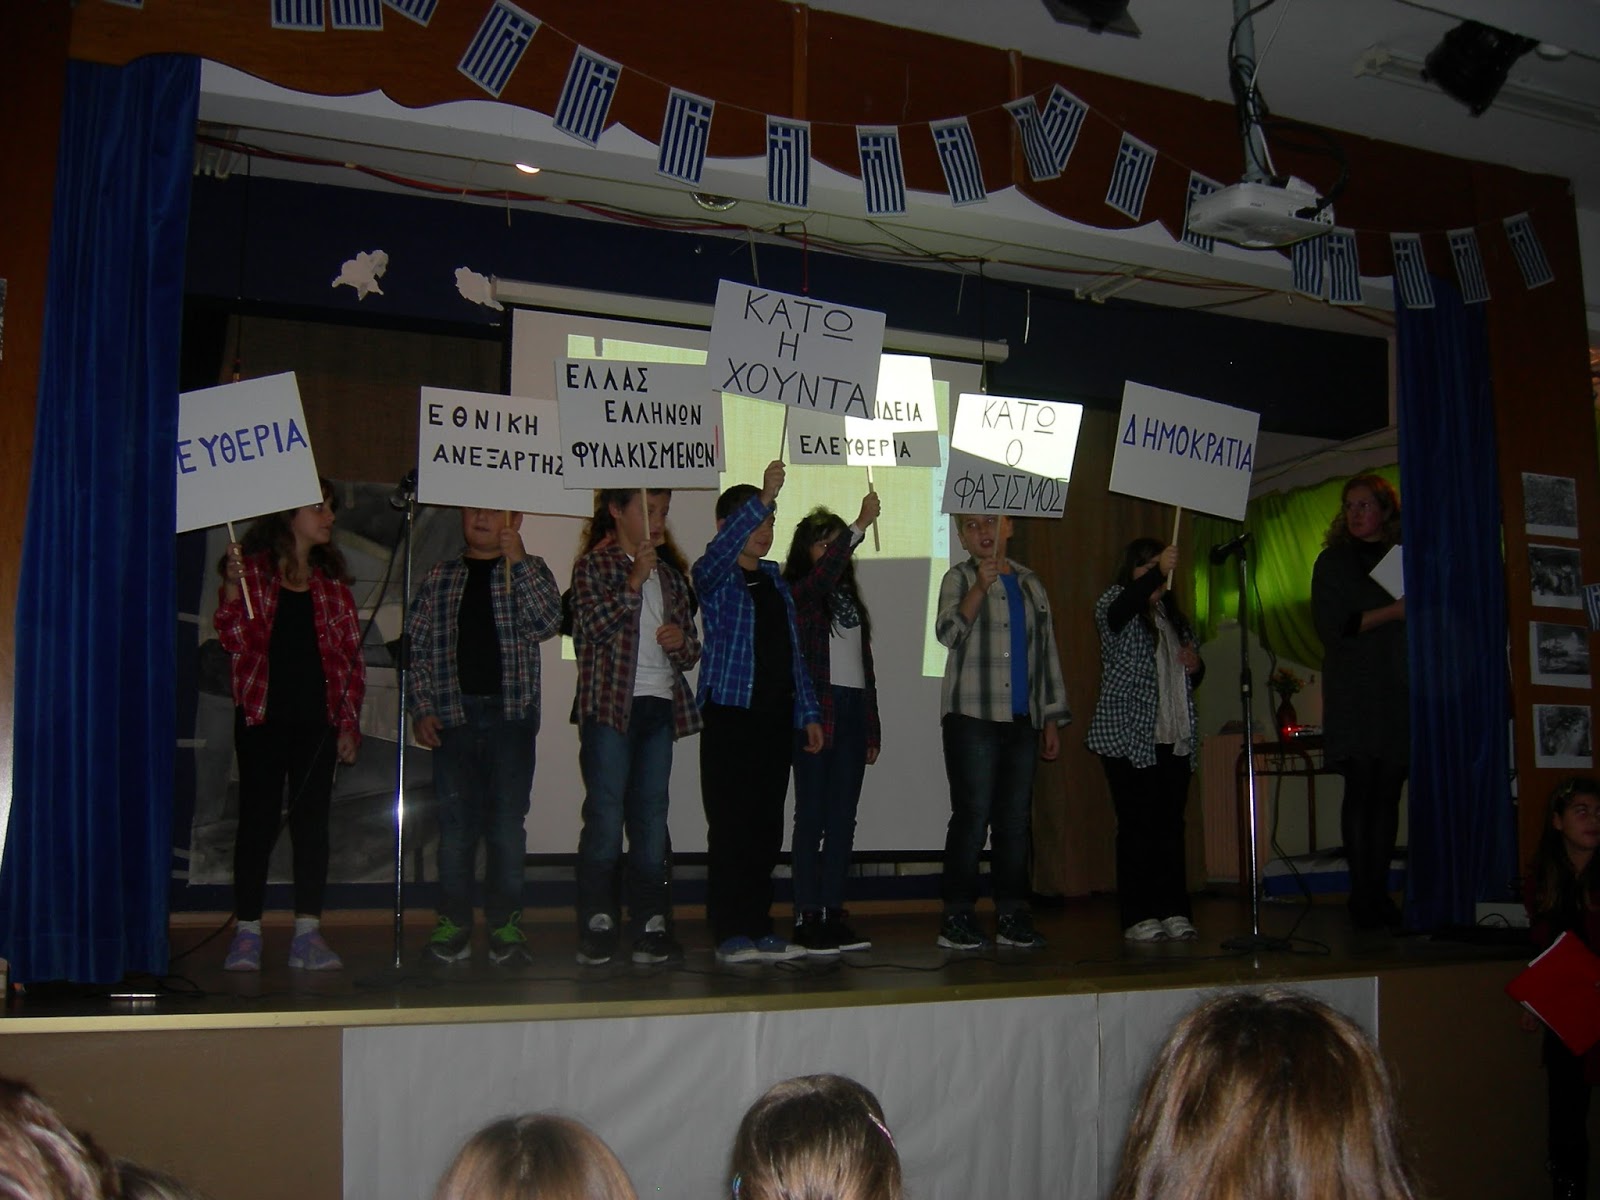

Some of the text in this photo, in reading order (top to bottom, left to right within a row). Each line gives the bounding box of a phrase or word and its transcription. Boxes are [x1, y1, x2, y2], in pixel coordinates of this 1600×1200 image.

[744, 289, 853, 341] ΚΑΤΩ
[778, 331, 799, 361] Η
[566, 363, 648, 392] ΕΛΛΑΣ
[722, 358, 869, 418] ΧΟΥΝΤΑ
[428, 403, 539, 436] ΕΘΝΙΚΗ
[605, 400, 702, 425] ΕΛΛΗΝΩΝ
[873, 400, 923, 422] ΙΔΕΙΑ
[981, 400, 1056, 434] ΚΑΤΩ
[571, 441, 715, 469] ΦΥΛΑΚΙΣΜΕΝΩΝ
[800, 435, 911, 458] ΕΛΕΥΘΕΡΙΑ
[1122, 413, 1252, 472] ΔΗΜΟΚΡΑΤΙΑ
[433, 444, 563, 476] ΑΝΕΞΑΡΤΗΣ
[954, 470, 1068, 512] ΦΑΣΙΣΜΟΣ
